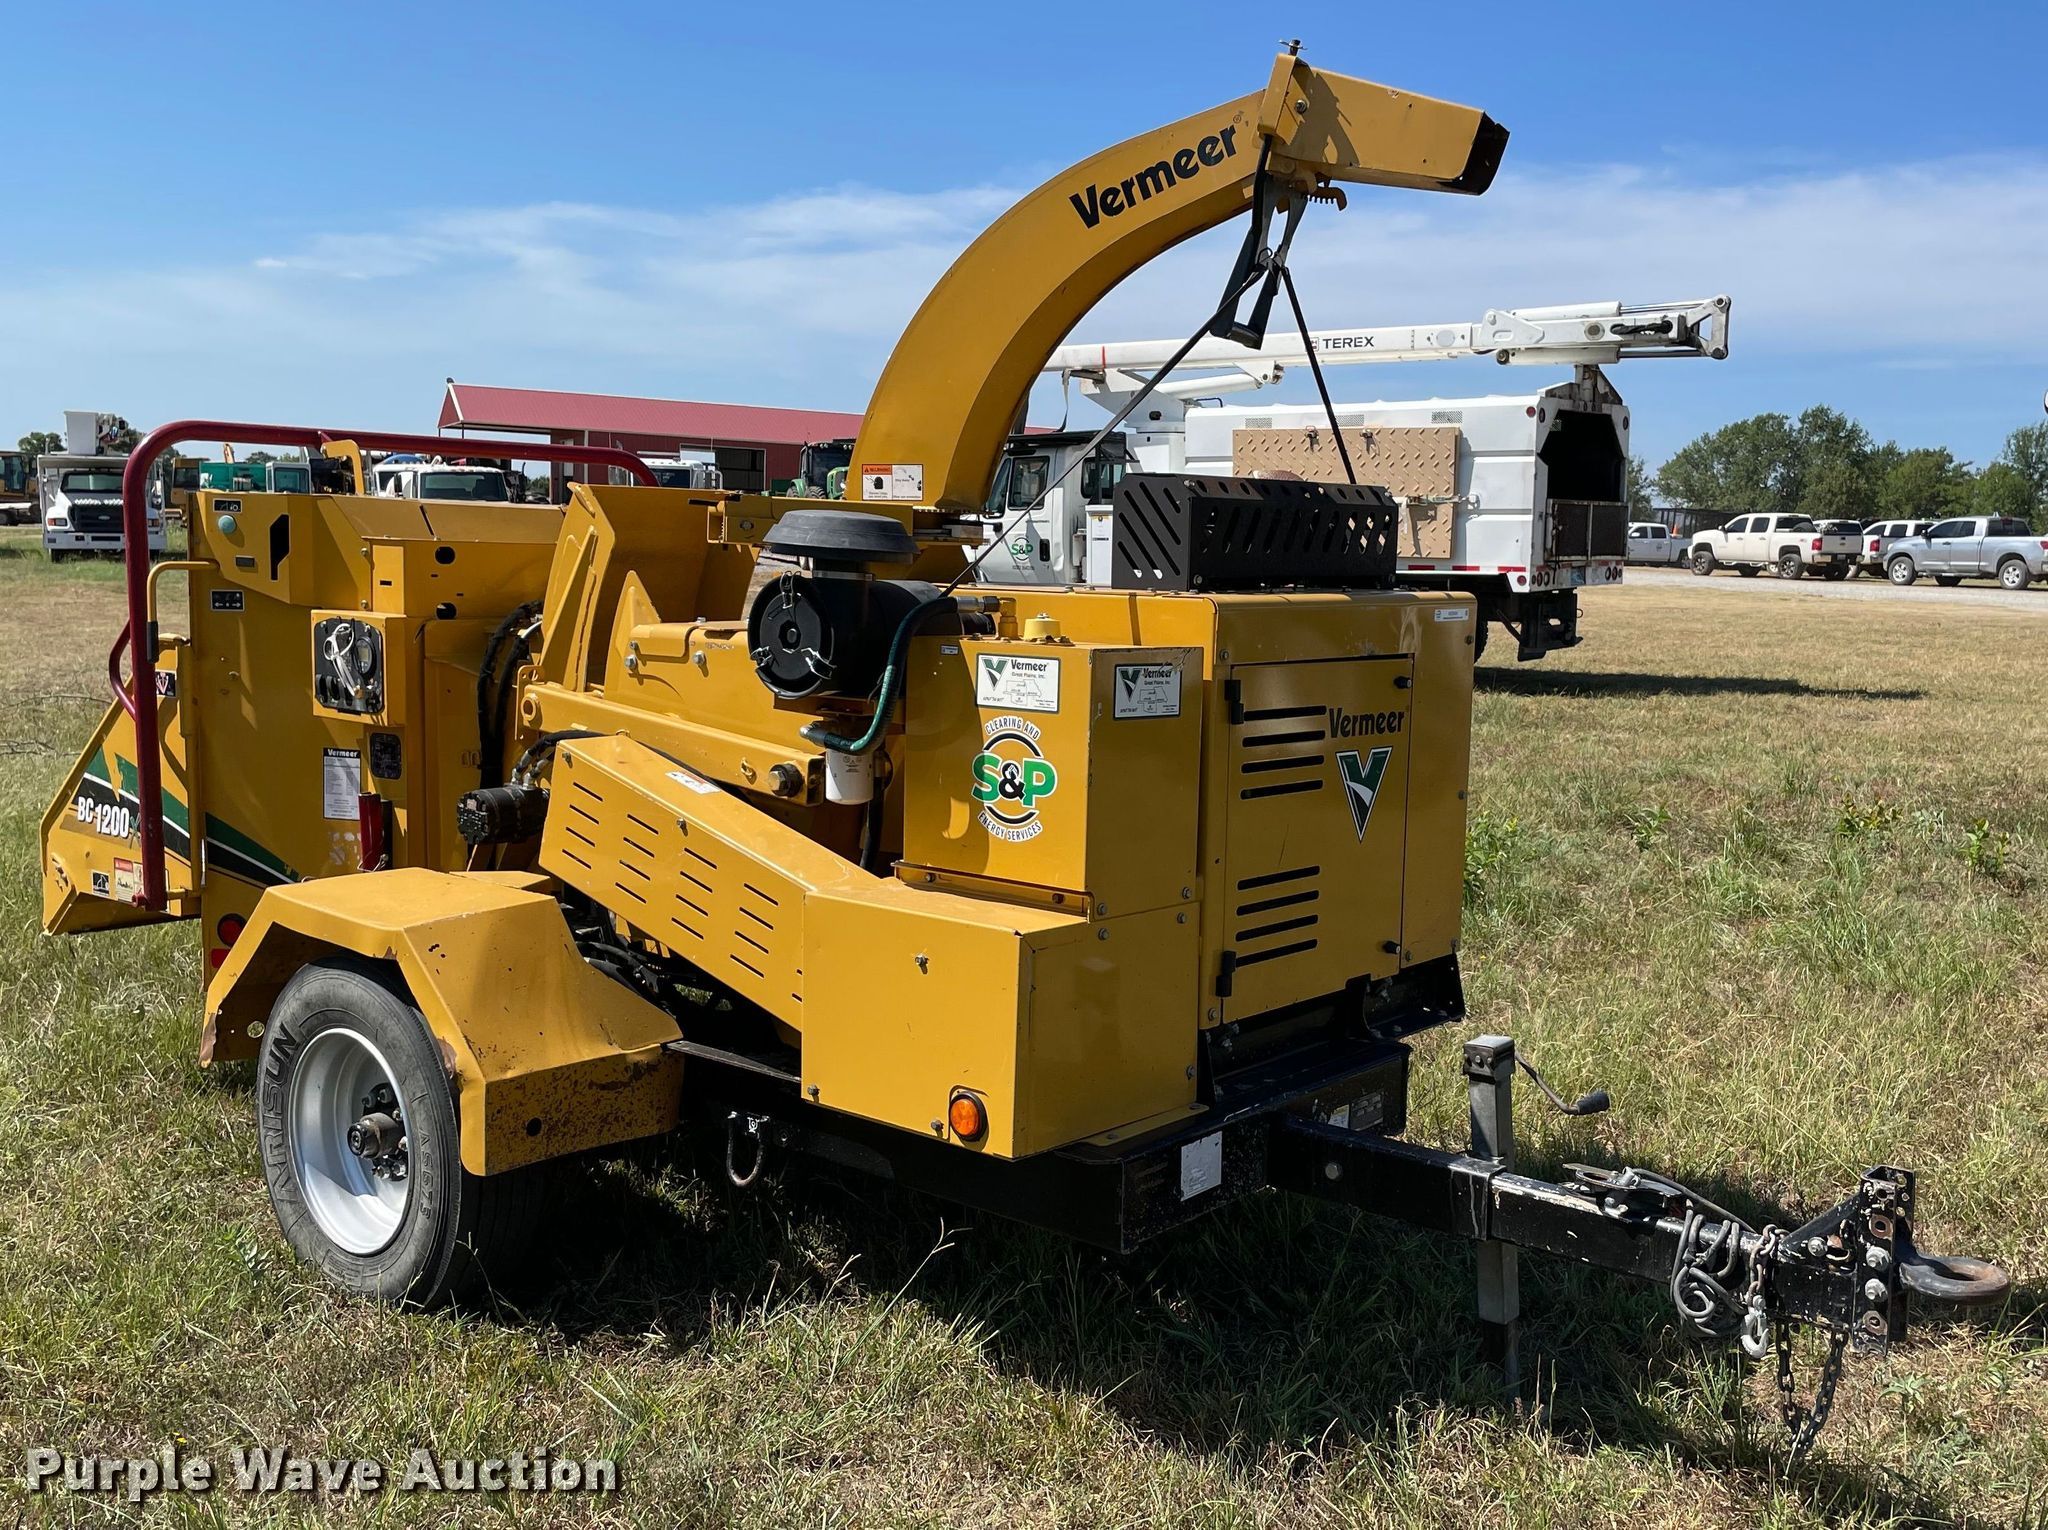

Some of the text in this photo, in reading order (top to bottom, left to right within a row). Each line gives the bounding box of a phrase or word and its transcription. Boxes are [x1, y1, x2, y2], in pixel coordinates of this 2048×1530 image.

[1069, 124, 1237, 229] Vermeer
[1322, 336, 1375, 349] TEREX
[1011, 543, 1034, 556] S&P
[1010, 659, 1047, 671] Vermeer
[1143, 667, 1173, 678] Vermeer
[985, 717, 1040, 740] CLEARING AND
[1329, 707, 1405, 738] Vermeer
[327, 748, 359, 758] Vermeer
[971, 753, 1057, 807] S&P
[978, 812, 1042, 841] ENERGY SERVICES
[263, 1022, 300, 1200] ARISUN
